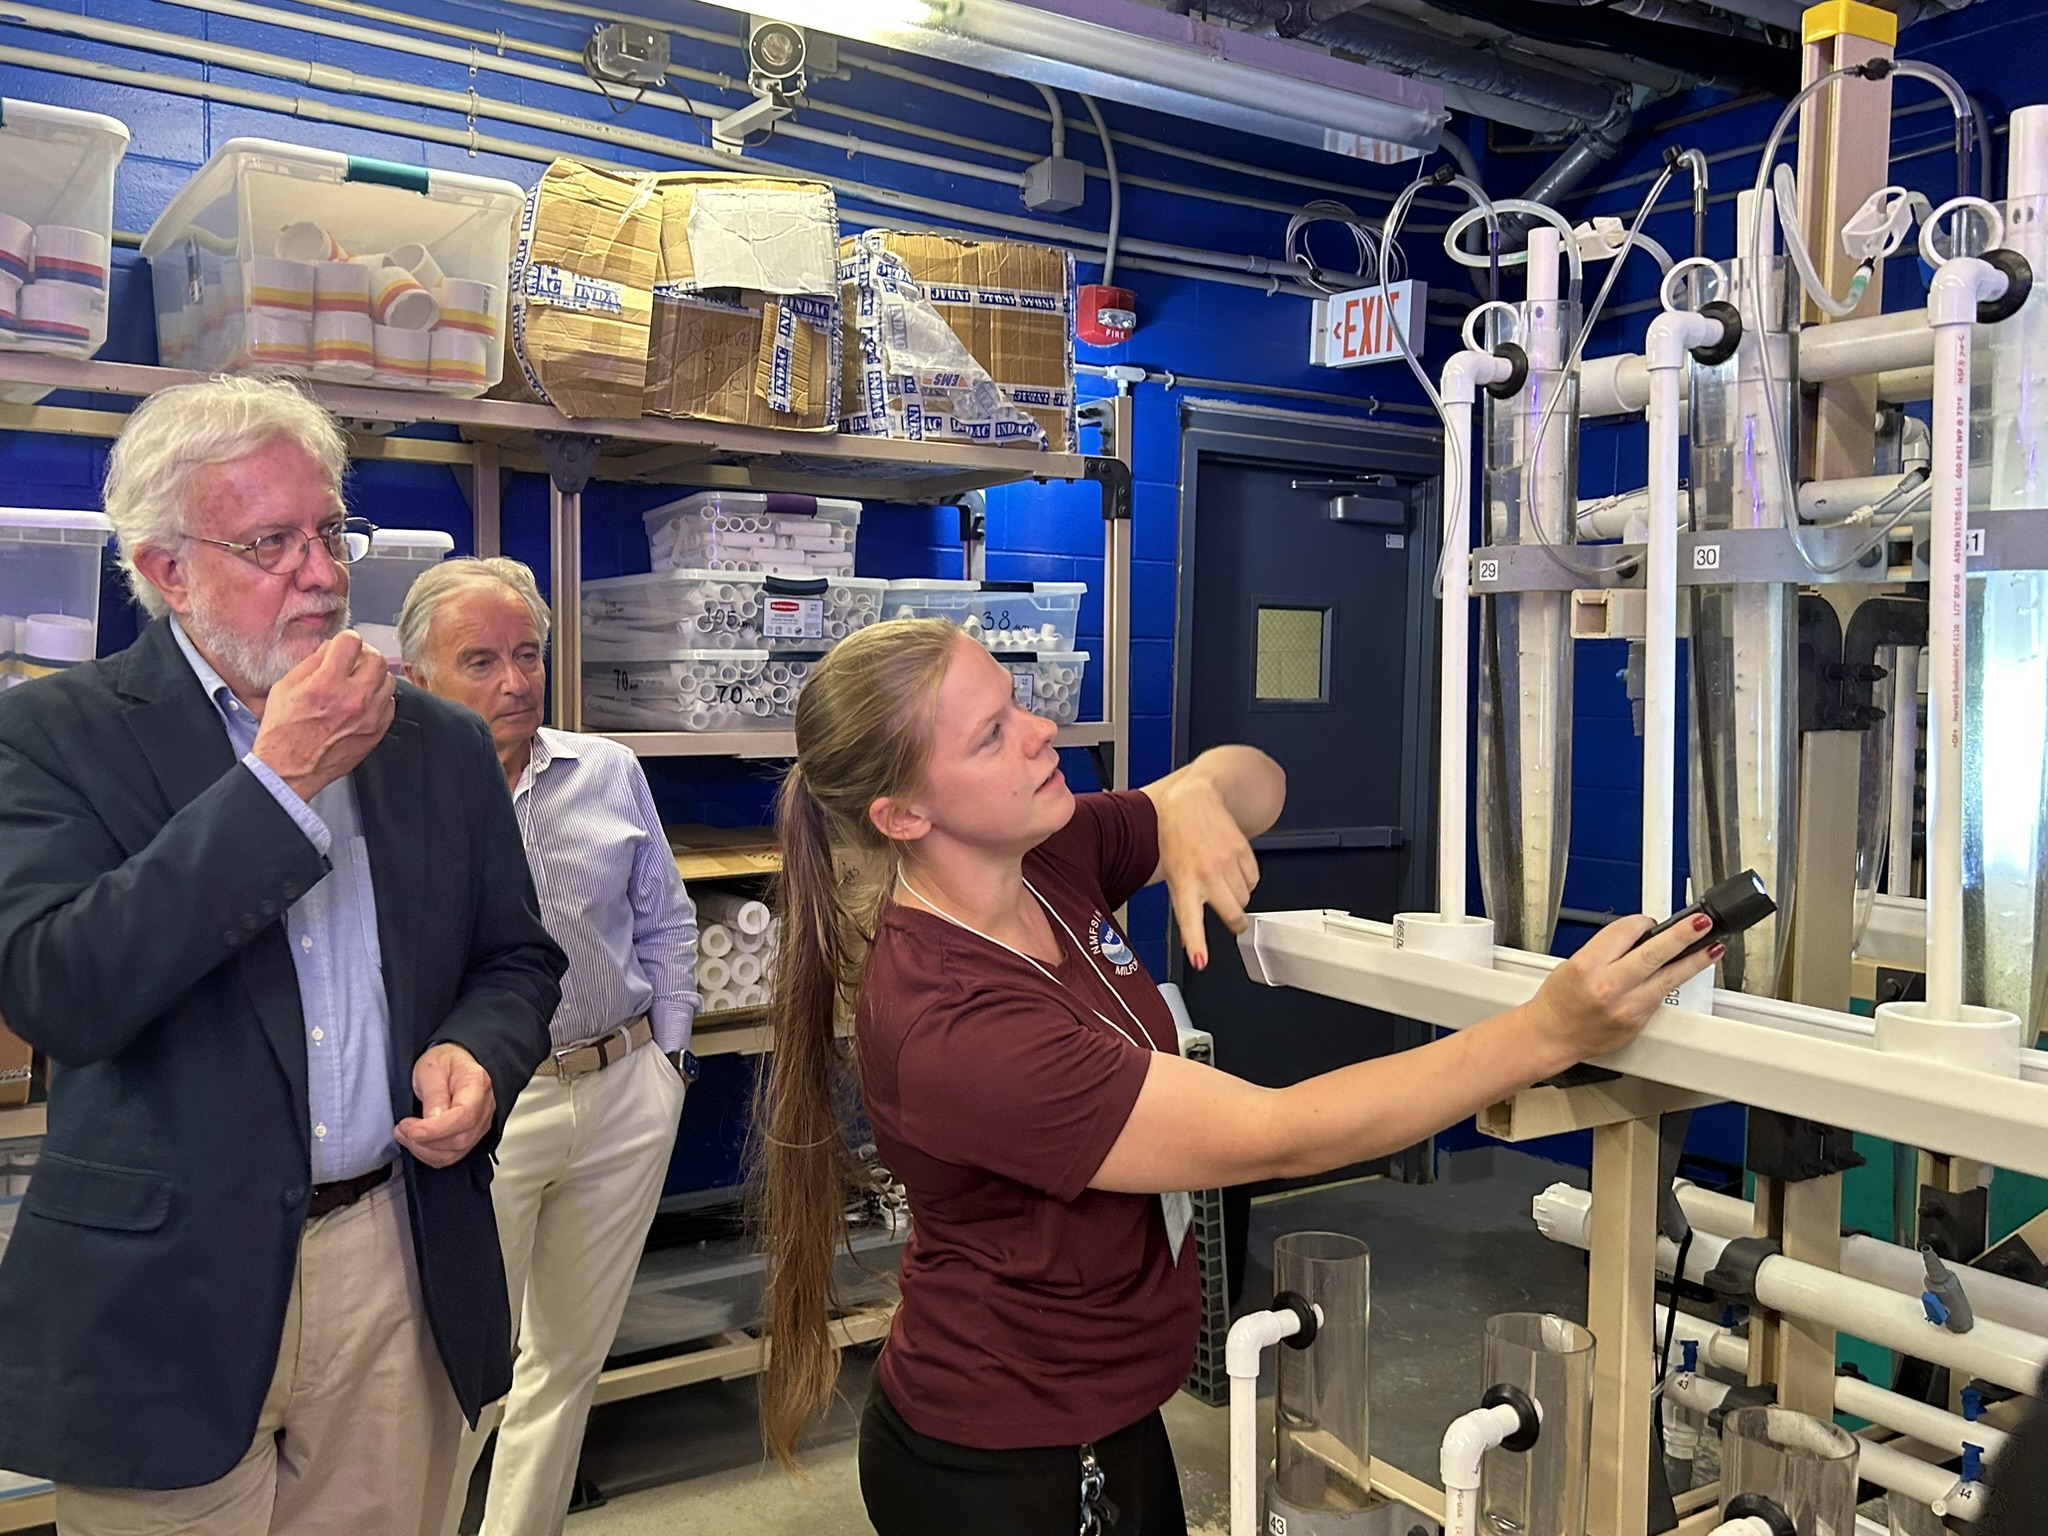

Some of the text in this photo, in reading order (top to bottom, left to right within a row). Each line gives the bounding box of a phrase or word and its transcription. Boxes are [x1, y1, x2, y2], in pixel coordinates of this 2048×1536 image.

[1105, 328, 1125, 339] FIRE
[1343, 291, 1399, 359] EXIT
[995, 421, 1032, 437] INDAC
[1956, 428, 1963, 443] WP
[1953, 540, 1961, 564] ASTM
[1966, 533, 1979, 552] 1
[1696, 548, 1717, 566] 30
[1481, 562, 1496, 578] 29
[705, 607, 737, 627] 105
[981, 610, 1011, 631] 38
[613, 667, 629, 691] 70
[715, 685, 742, 704] 70
[1677, 1379, 1689, 1390] 43
[1270, 1516, 1285, 1535] 43
